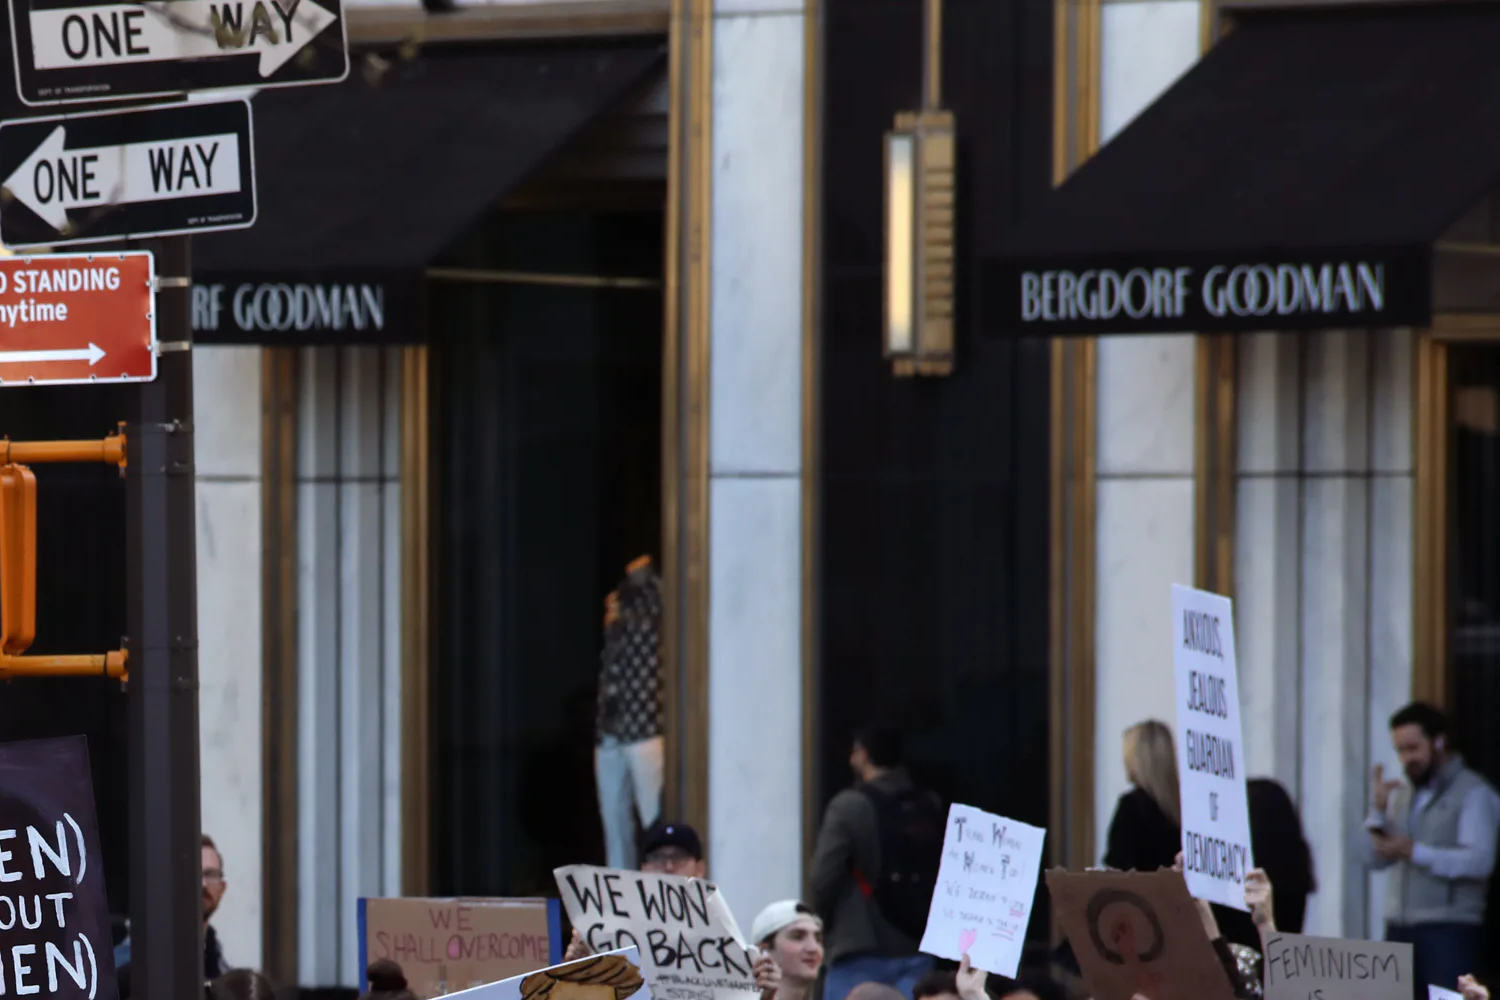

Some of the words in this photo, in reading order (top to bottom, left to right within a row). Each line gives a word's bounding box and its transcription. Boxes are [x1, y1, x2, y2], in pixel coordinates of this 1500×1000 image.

[61, 10, 150, 60] ONE
[209, 1, 300, 49] WAY
[33, 154, 100, 204] ONE
[149, 142, 219, 193] WAY
[13, 267, 121, 293] STANDING
[1021, 267, 1193, 322] BERGDORF
[1203, 262, 1384, 318] GOODMAN
[233, 282, 385, 331] GOODMAN
[1187, 669, 1228, 719] JEALOUS
[1186, 728, 1235, 780] GUARDIAN
[1186, 830, 1247, 884] DEMOCRACY
[428, 907, 473, 931] WE
[565, 872, 631, 918] WE
[376, 930, 443, 963] SHALL
[446, 932, 549, 963] OVERCOME
[1267, 937, 1400, 986] FEMINISM
